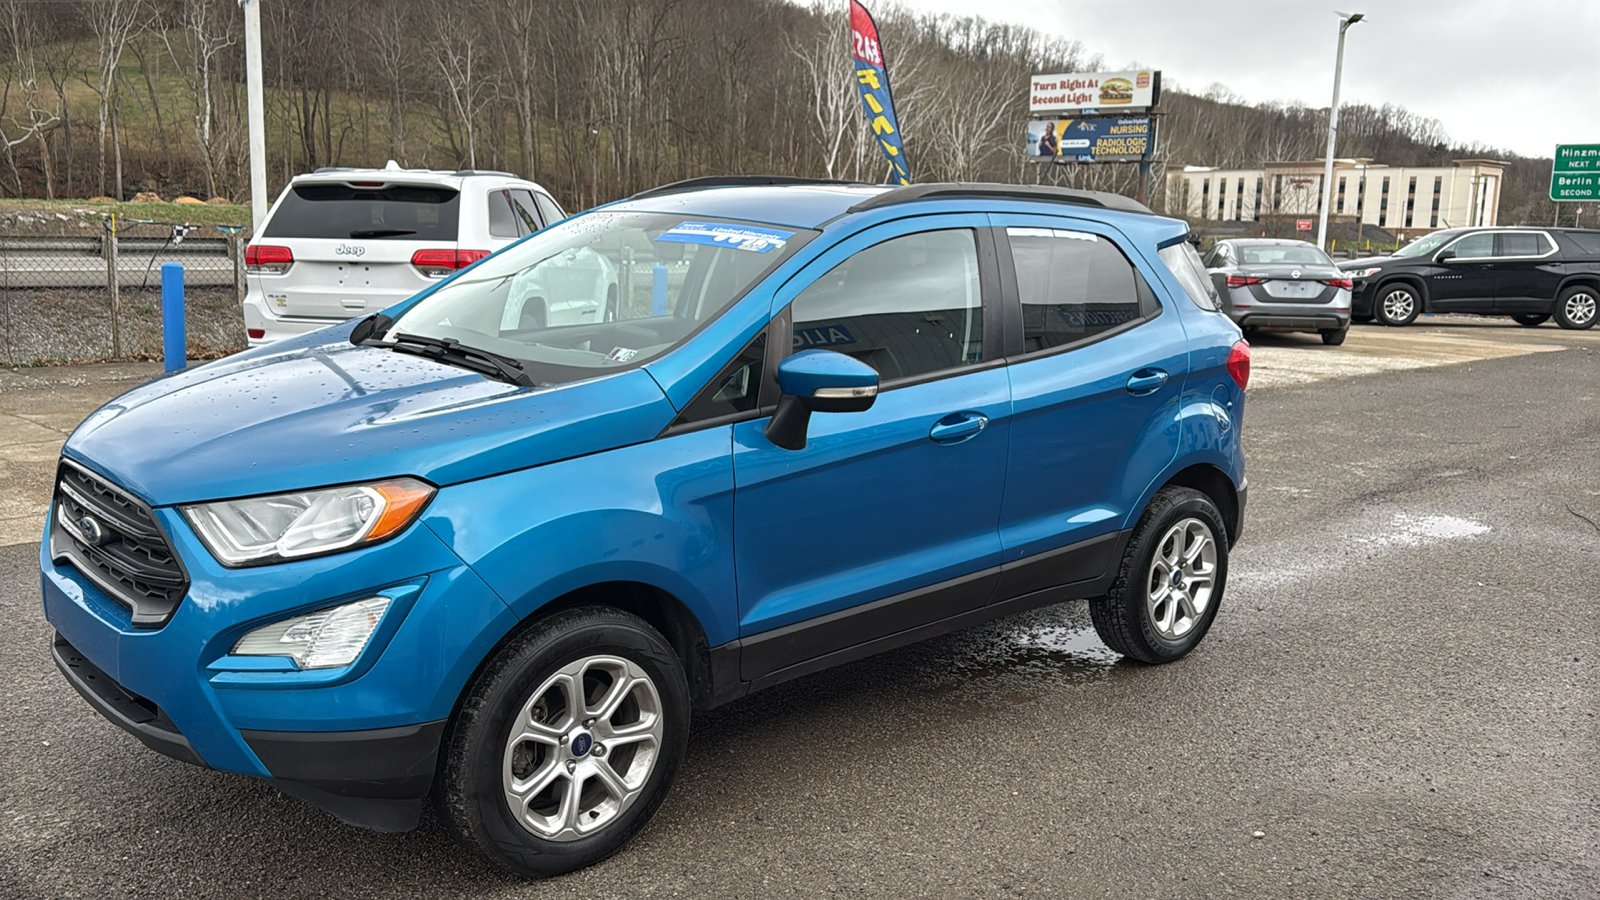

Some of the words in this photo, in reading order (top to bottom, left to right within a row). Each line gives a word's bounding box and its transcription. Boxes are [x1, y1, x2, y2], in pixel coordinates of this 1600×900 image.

[1033, 81, 1057, 91] Turn
[1060, 79, 1086, 91] Right
[1087, 79, 1098, 88] At
[1032, 94, 1065, 105] Second
[1067, 93, 1092, 104] Light
[1110, 124, 1148, 134] NURSING
[1096, 137, 1147, 147] RADIOLOGIC
[1091, 146, 1147, 155] TECHNOLOGY
[1558, 177, 1592, 185] Berlin
[711, 226, 743, 235] Limited
[743, 229, 782, 240] Warranty
[336, 244, 365, 257] Jeep
